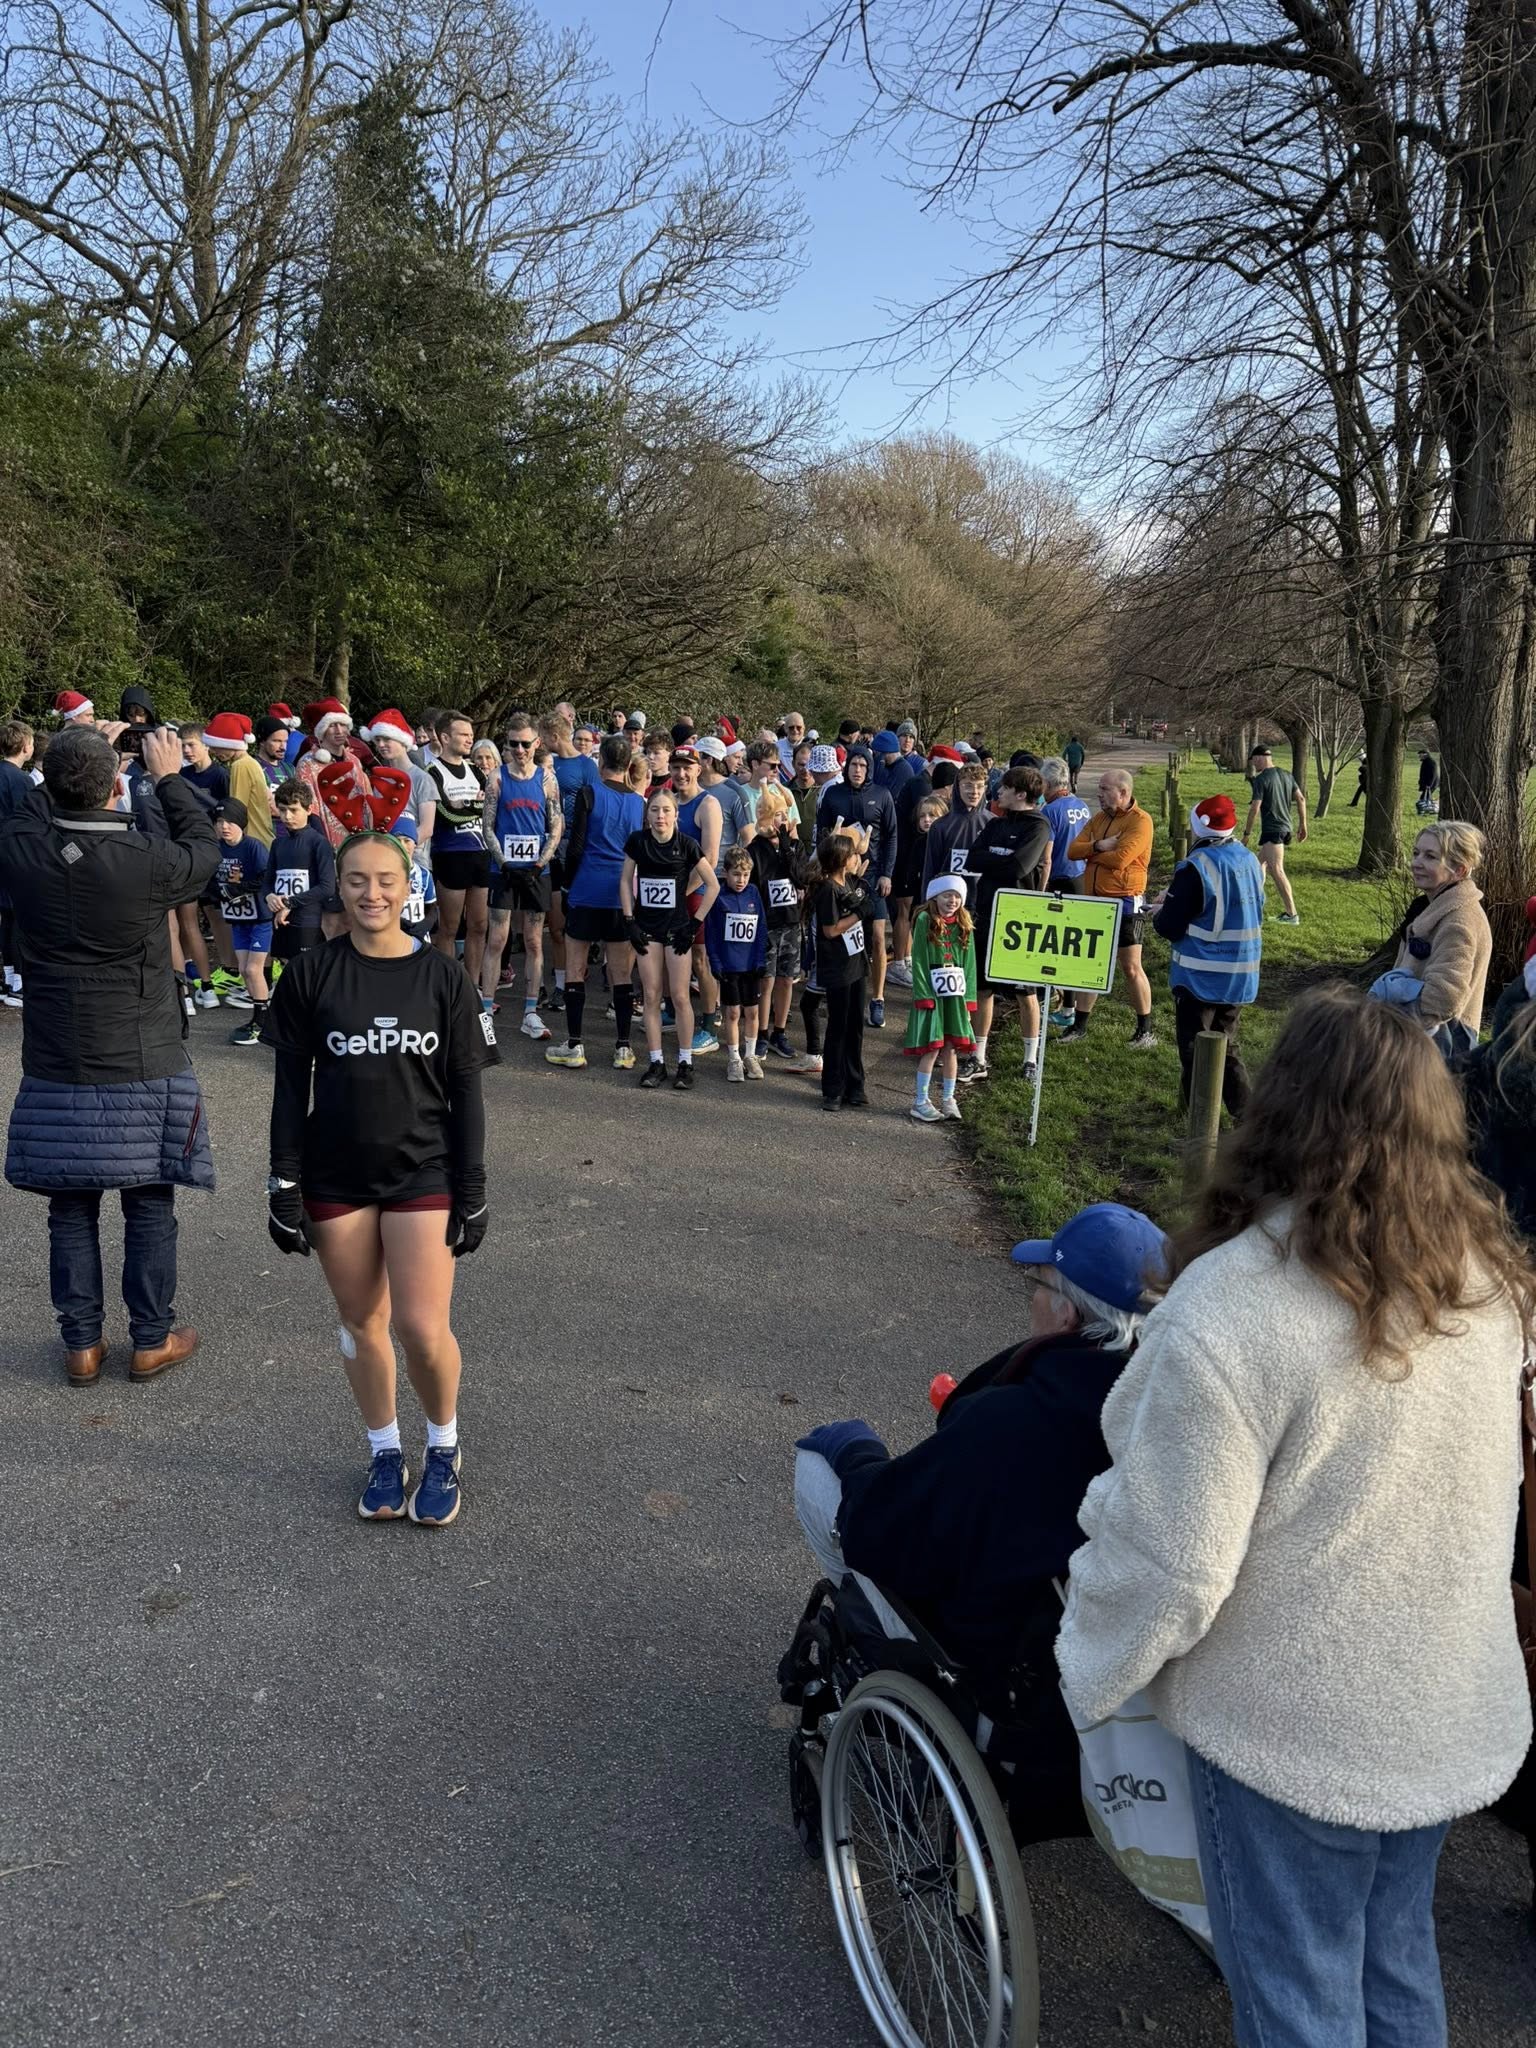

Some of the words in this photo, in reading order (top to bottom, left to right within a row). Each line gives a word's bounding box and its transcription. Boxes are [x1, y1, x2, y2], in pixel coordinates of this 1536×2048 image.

[1066, 808, 1089, 824] 500
[508, 843, 534, 859] 144
[277, 878, 304, 896] 216
[644, 887, 670, 904] 122
[771, 883, 795, 904] 224
[404, 902, 420, 920] 14
[729, 922, 754, 940] 106
[1002, 920, 1103, 958] START
[935, 975, 964, 993] 202
[326, 1029, 439, 1056] GetPRO
